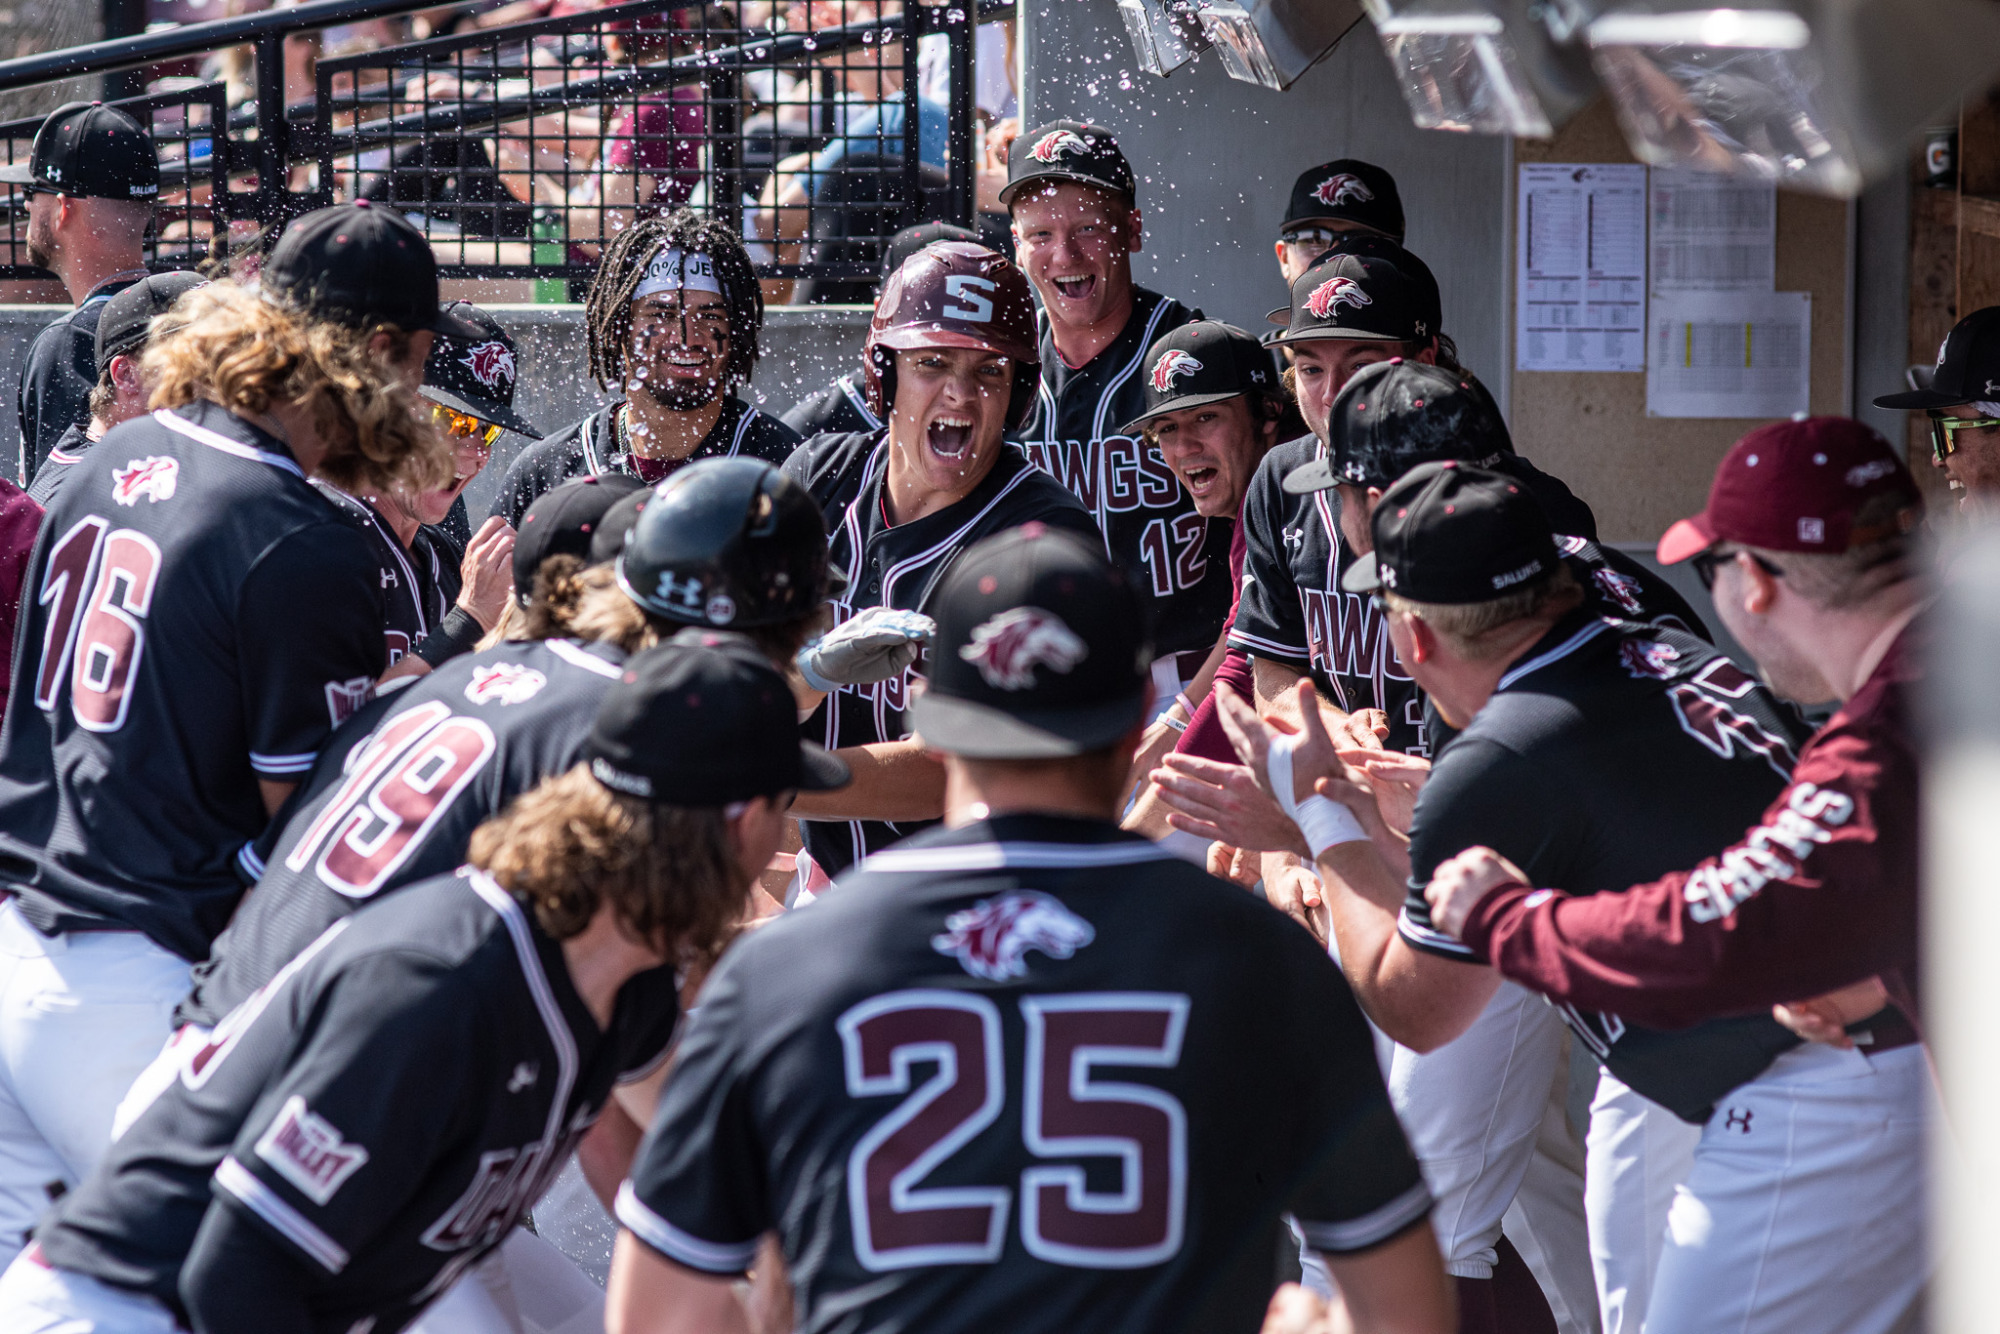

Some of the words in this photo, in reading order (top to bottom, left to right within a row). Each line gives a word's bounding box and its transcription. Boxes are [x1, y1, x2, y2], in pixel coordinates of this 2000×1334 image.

[689, 261, 718, 278] JE
[942, 274, 996, 323] S
[34, 514, 162, 733] 16
[1139, 510, 1209, 598] 12
[285, 699, 497, 899] 19
[835, 988, 1192, 1272] 25
